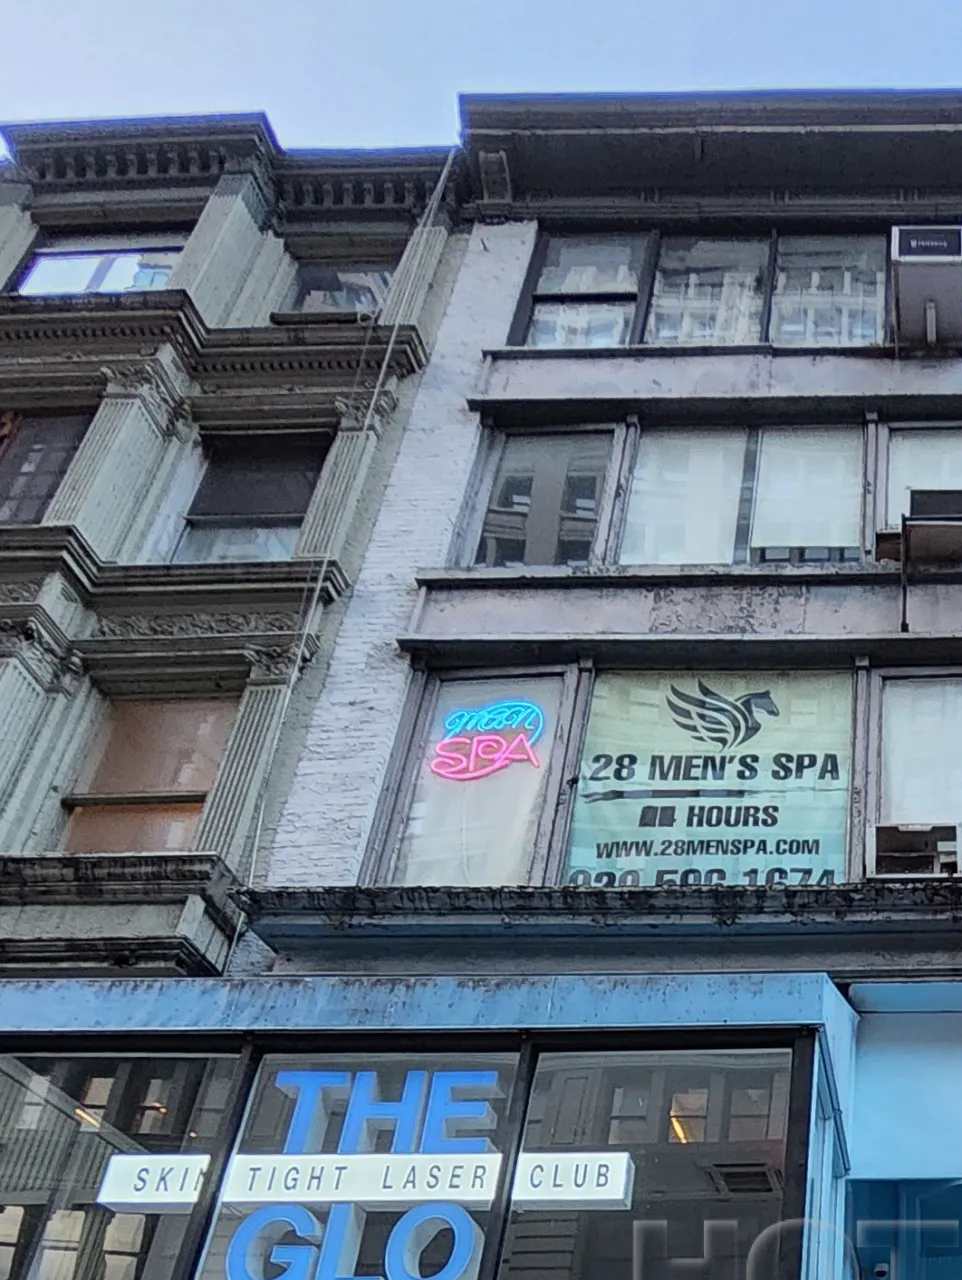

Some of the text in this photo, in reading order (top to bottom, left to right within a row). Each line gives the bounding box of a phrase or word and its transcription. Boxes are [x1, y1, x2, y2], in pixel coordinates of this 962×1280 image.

[431, 732, 540, 779] SPA
[588, 752, 841, 782] 28 MEN'S SPA
[686, 805, 779, 828] HOURS
[594, 838, 821, 859] WWW.28MENSPA.COM
[274, 1070, 498, 1154] THE
[248, 1166, 349, 1192] TIGHT
[381, 1164, 487, 1190] LASER
[529, 1163, 611, 1189] CLUB
